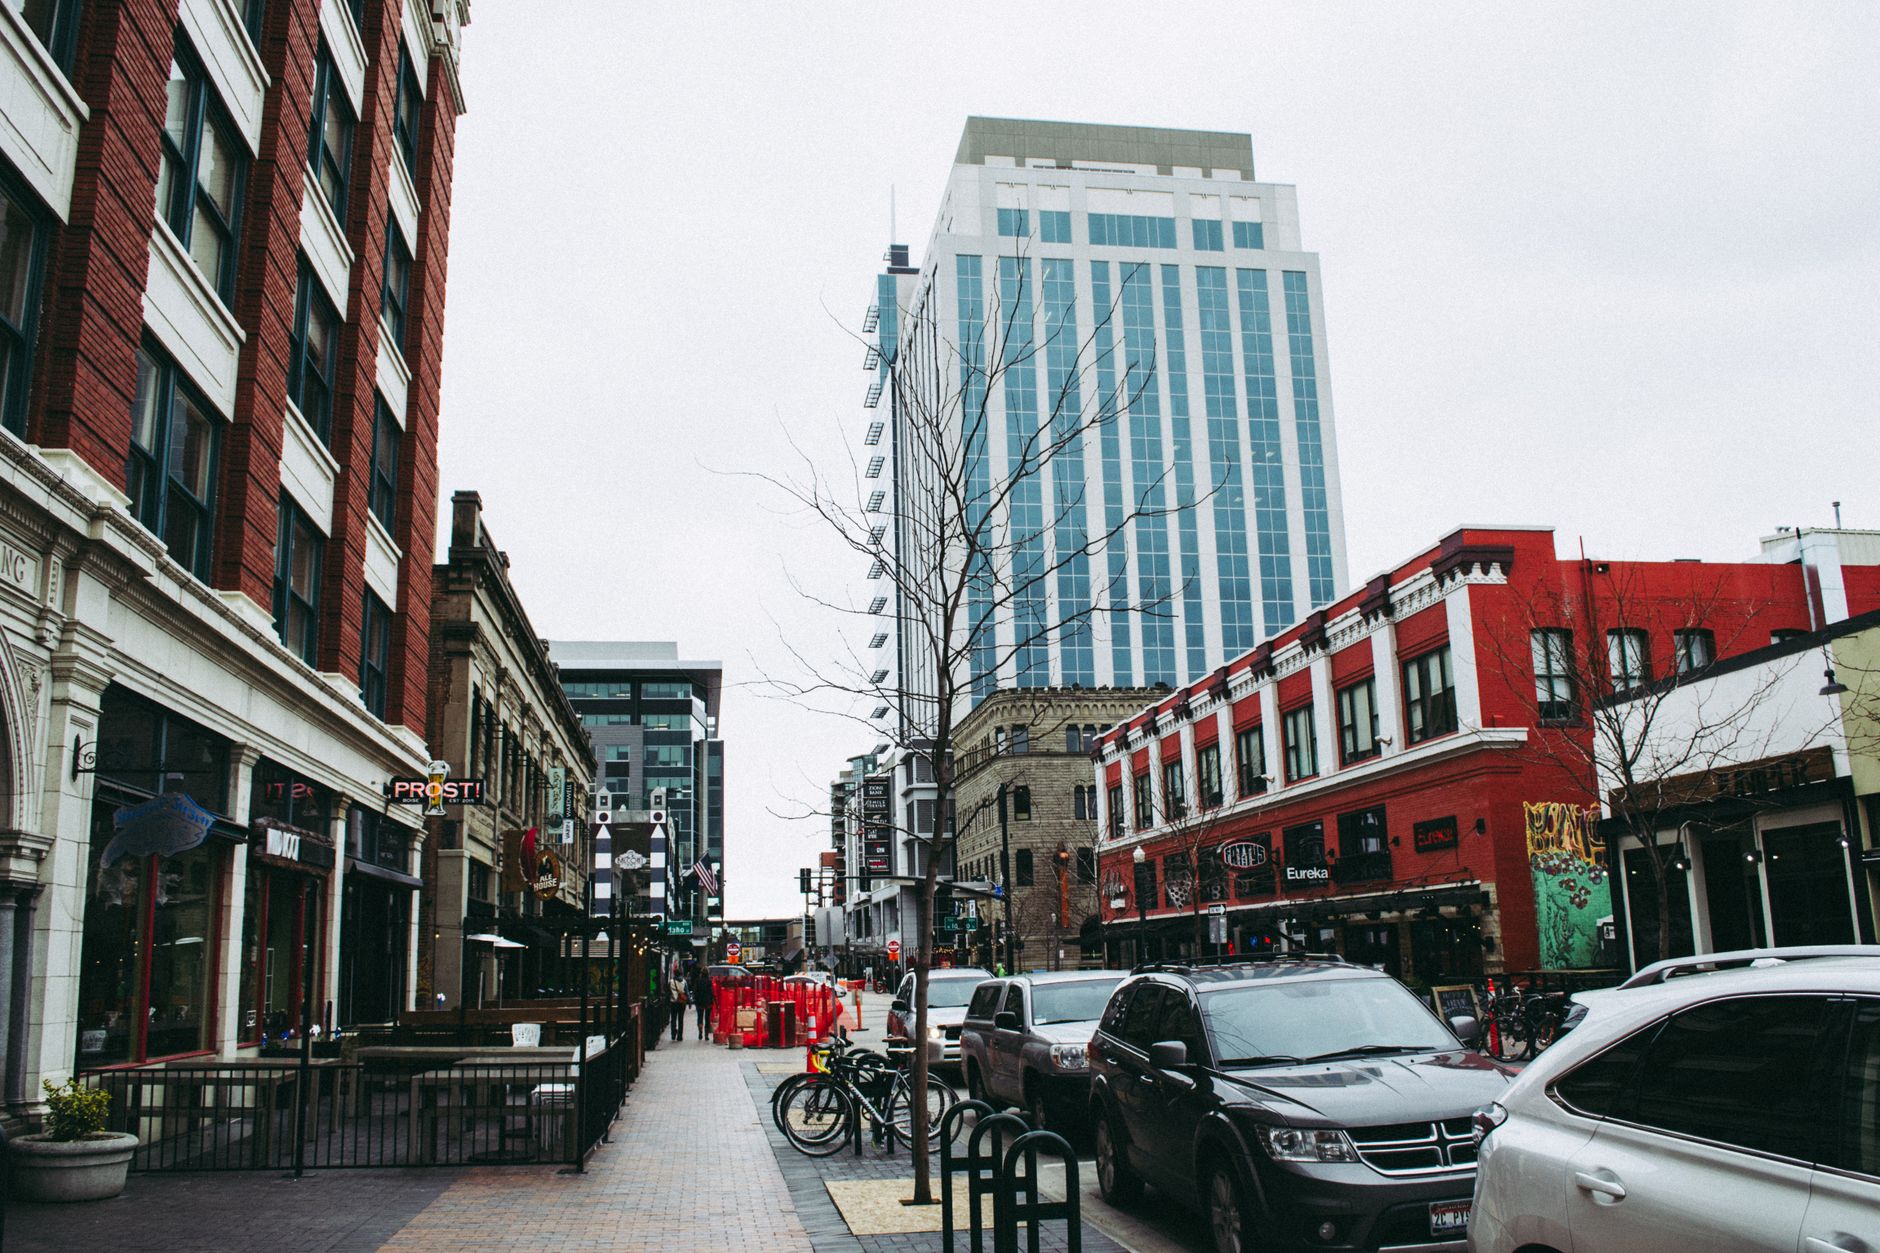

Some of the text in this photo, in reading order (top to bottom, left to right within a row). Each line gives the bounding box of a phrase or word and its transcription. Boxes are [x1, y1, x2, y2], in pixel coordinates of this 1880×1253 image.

[394, 781, 480, 798] PROST!
[539, 873, 553, 883] ALE
[1286, 867, 1329, 880] Eureka
[533, 877, 557, 891] HOUSE
